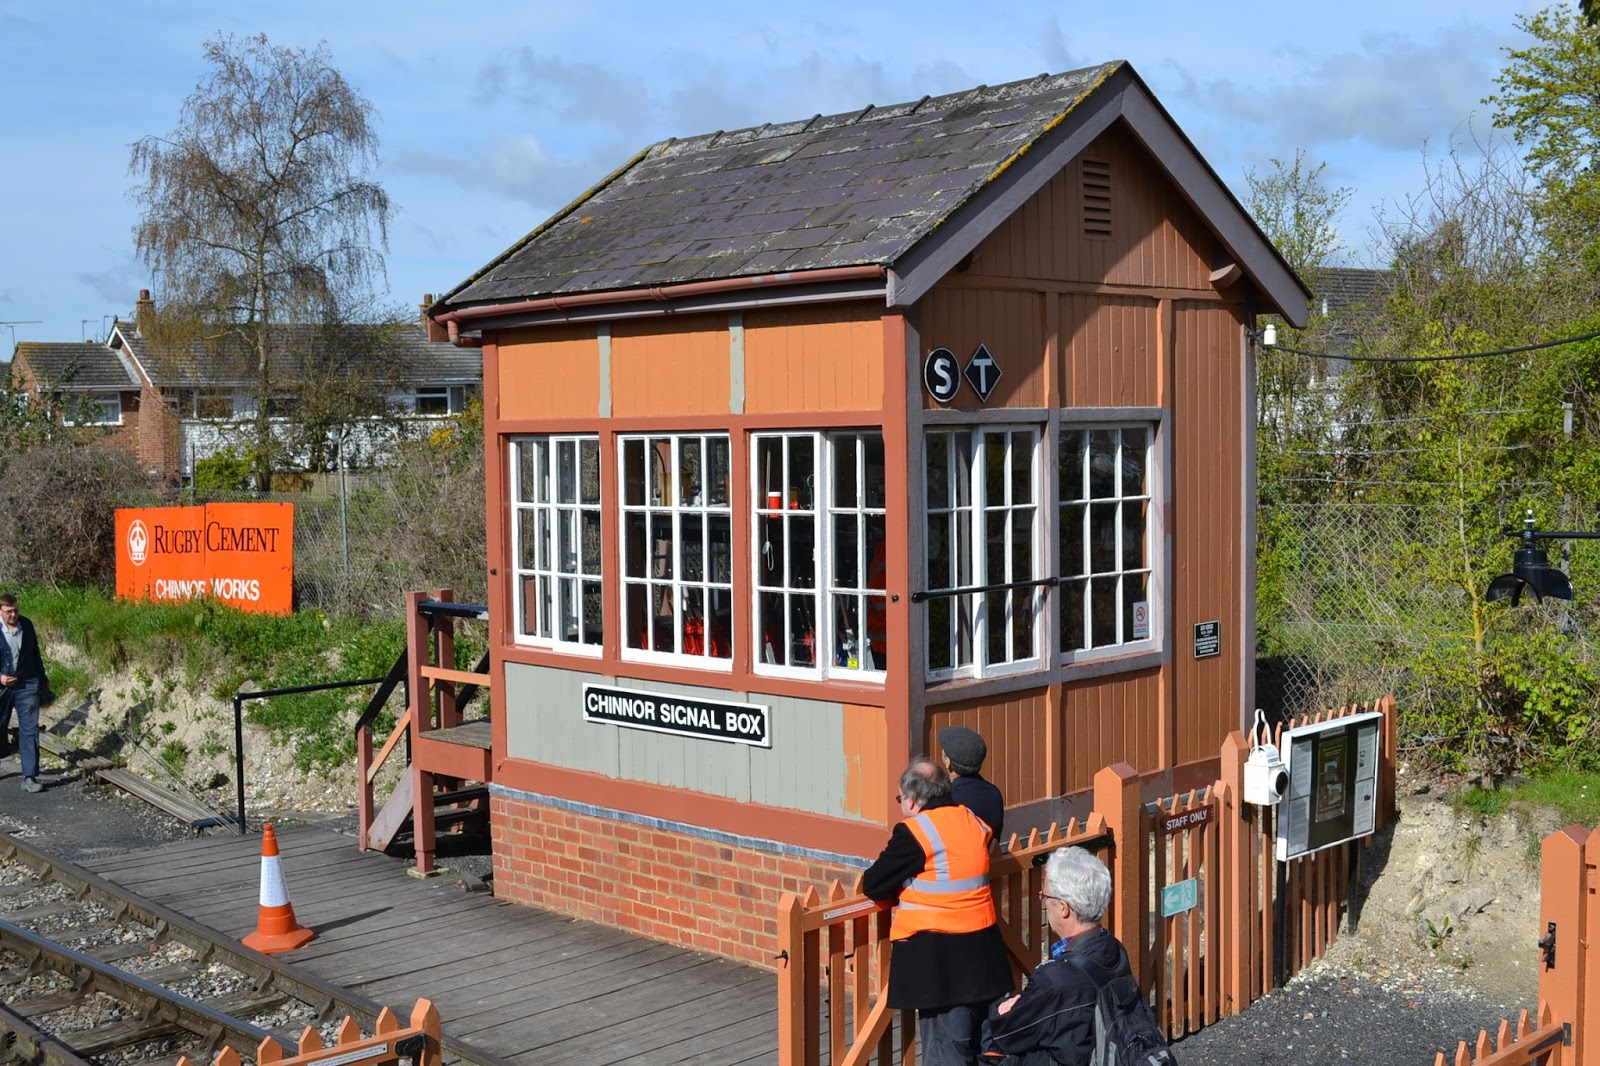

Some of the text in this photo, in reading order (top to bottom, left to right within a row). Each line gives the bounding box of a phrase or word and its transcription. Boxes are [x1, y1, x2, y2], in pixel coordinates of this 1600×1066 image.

[934, 357, 952, 394] S
[972, 358, 993, 393] T
[154, 521, 279, 554] RUGBY CEMENT
[210, 578, 260, 601] WORKS
[587, 693, 761, 735] CHINNOR SIGNAL BOX
[1166, 809, 1207, 830] STAFF ONLY
